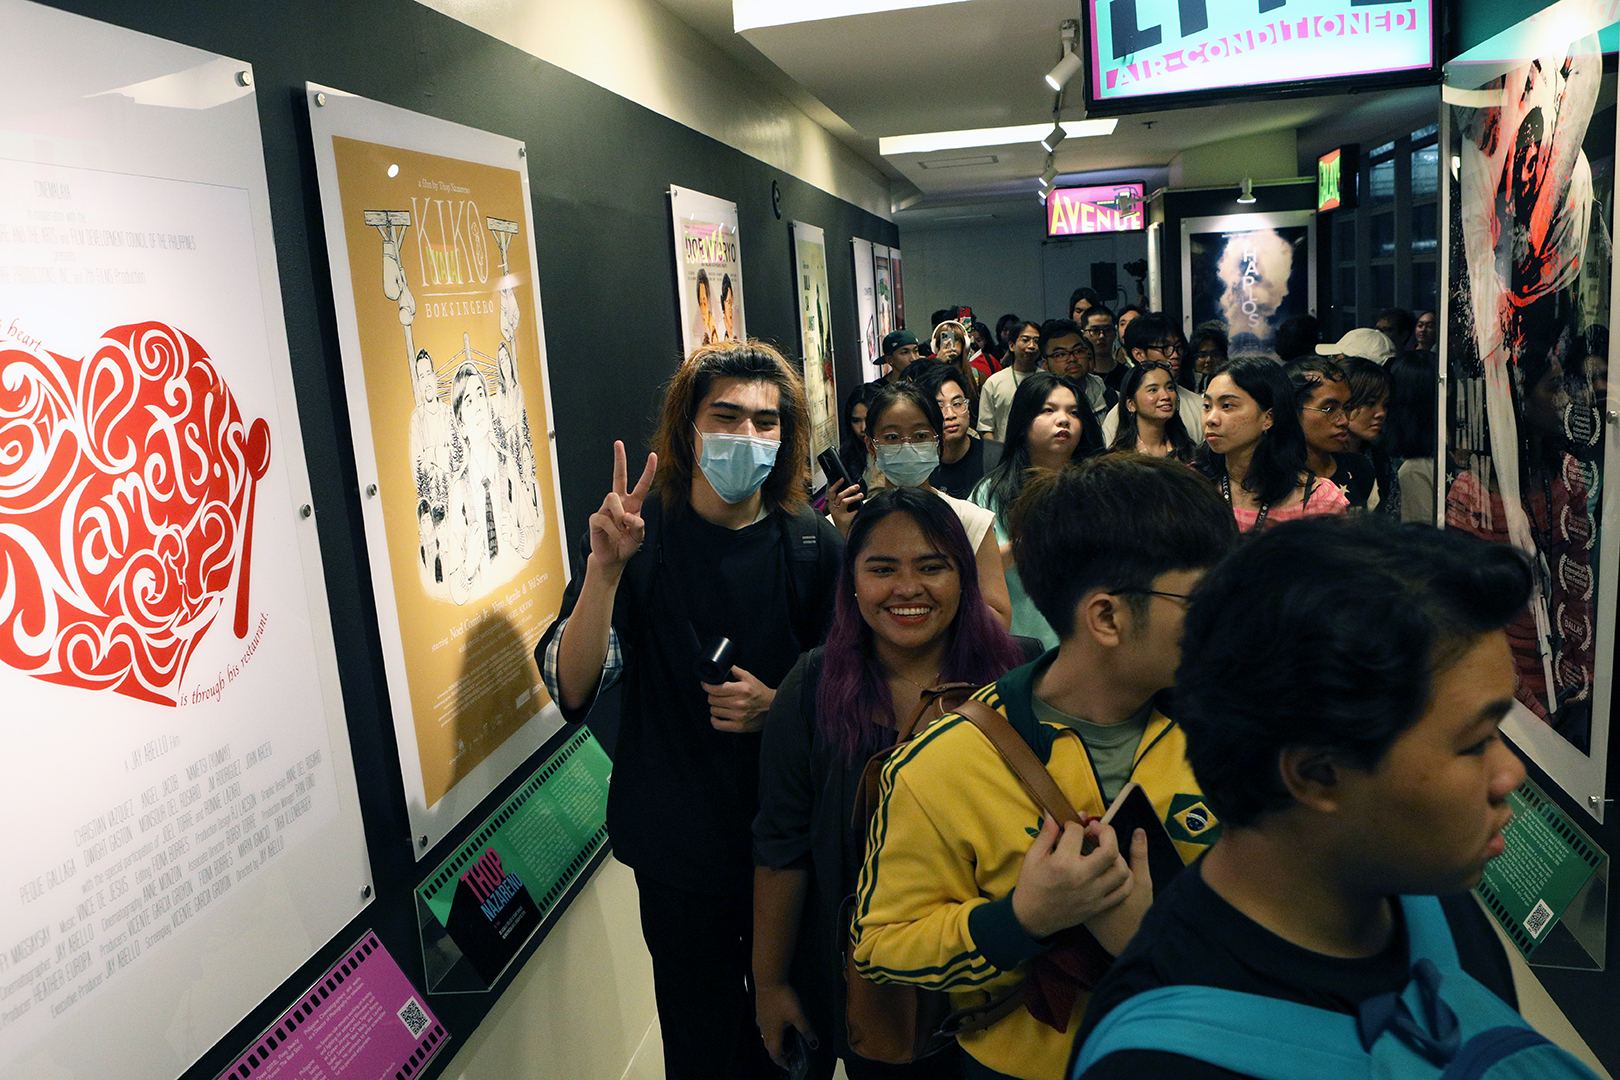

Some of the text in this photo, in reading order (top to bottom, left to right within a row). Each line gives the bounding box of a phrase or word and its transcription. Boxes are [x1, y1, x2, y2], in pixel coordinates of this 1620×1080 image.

[1106, 8, 1416, 90] AIR-CONDITIONED
[34, 179, 72, 200] CINEMALAYA
[421, 179, 432, 190] film
[432, 180, 438, 192] by
[438, 181, 450, 193] Thop
[449, 183, 471, 195] Nazareno
[33, 210, 64, 222] cooperation
[77, 212, 86, 223] the
[1050, 192, 1141, 234] AVENUE
[12, 225, 26, 243] AND
[26, 225, 40, 244] THE
[42, 226, 58, 245] ARTS
[59, 233, 69, 245] and
[70, 228, 85, 246] FILM
[86, 228, 124, 248] DEVELOPMENT
[126, 231, 149, 248] COUNCIL
[148, 232, 156, 249] OF
[156, 233, 168, 250] THE
[168, 234, 197, 251] PHILIPPINES
[52, 250, 76, 263] presents
[411, 197, 488, 287] KIKO
[96, 268, 114, 285] FILMS
[115, 268, 146, 285] Production
[1241, 248, 1260, 328] HAPLOS
[424, 300, 495, 319] BOKSINGERO
[7, 318, 45, 352] heart
[1564, 562, 1588, 583] International
[1564, 570, 1587, 589] Film Festival
[1566, 555, 1586, 575] Edinburgh
[431, 636, 450, 653] starring
[449, 623, 466, 641] Noel
[482, 608, 491, 623] Jr.
[521, 585, 528, 597] &
[535, 571, 549, 588] Servo
[1564, 617, 1584, 638] DALLAS
[179, 612, 269, 707] is through his restaurant.
[131, 748, 143, 771] JAY
[143, 734, 169, 763] ABELLO
[73, 773, 180, 847] CHRISTIAN VAZQUEZ ANGEL JACOB
[83, 837, 108, 868] DWIGHT
[108, 824, 133, 853] GASTON
[138, 804, 167, 833] MONSOUR
[166, 798, 179, 818] DEL
[178, 783, 202, 809] ROSARIO
[82, 878, 94, 894] with
[94, 871, 105, 887] the
[104, 858, 123, 882] special
[123, 840, 155, 871] participation
[161, 822, 176, 844] JOEL
[176, 809, 194, 834] TORRE
[203, 791, 223, 817] RONNIE
[222, 780, 242, 808] LAZARO
[19, 857, 77, 906] PEQUE GALLAGA
[58, 915, 77, 934] Music
[76, 896, 96, 922] VINCE
[95, 888, 107, 910] DE
[108, 875, 129, 903] JESUS
[134, 865, 153, 885] Editing
[151, 850, 169, 873] FIONA
[194, 822, 218, 845] Production
[458, 847, 507, 904] THOP
[480, 871, 523, 922] NAZARENO
[55, 940, 67, 965] JAY
[67, 922, 95, 953] ABELLO
[142, 879, 158, 903] ANNE
[158, 863, 183, 892] MONZON
[32, 968, 65, 1005] HEATHER
[64, 949, 94, 982] EUROPA
[126, 907, 152, 938] VICENTE
[151, 894, 172, 921] GARCIA
[105, 957, 116, 980] JAY
[116, 939, 141, 971] ABELLO
